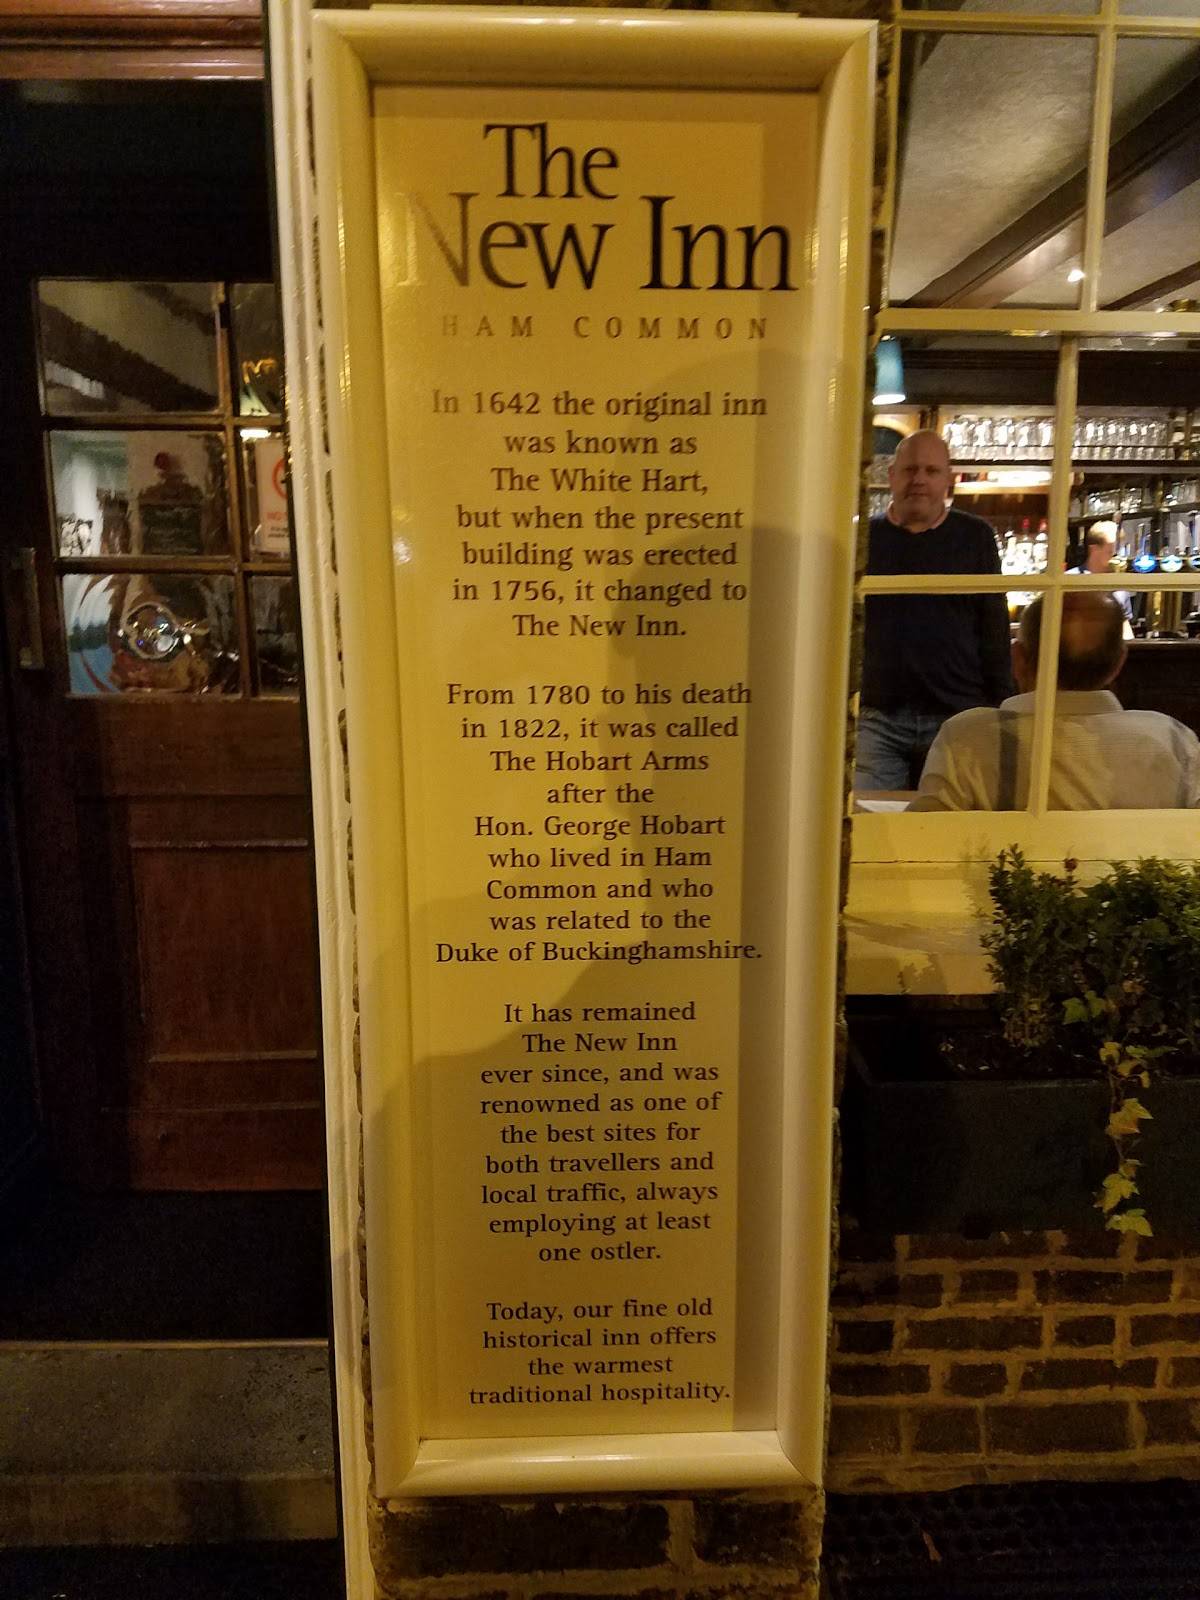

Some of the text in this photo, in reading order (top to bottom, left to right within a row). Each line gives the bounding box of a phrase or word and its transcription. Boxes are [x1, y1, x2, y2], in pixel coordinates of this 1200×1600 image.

[483, 122, 619, 199] The
[400, 190, 799, 291] New Inn
[442, 314, 767, 340] HAM COMMON
[433, 390, 768, 423] In 1642 the original inn
[503, 429, 697, 455] was known as
[490, 467, 708, 496] The White Hart,
[456, 504, 744, 536] but when the present
[462, 541, 739, 572] building was erected
[453, 578, 747, 607] in 1756, it changed to
[512, 614, 687, 637] The New Inn.
[447, 682, 753, 705] From 1780 to his death
[461, 716, 739, 741] in 1822, it was called
[490, 750, 709, 771] The Hobart Arms
[547, 782, 655, 804] after the
[474, 814, 726, 841] Hon. George Hobart
[488, 847, 712, 868] who lived in Ham
[487, 878, 714, 899] Common and who
[489, 909, 711, 930] was related to the
[435, 937, 763, 965] Duke of Buckinghamshire.
[504, 1001, 697, 1022] It has remained
[522, 1032, 678, 1053] The New Inn
[481, 1062, 719, 1085] ever since, and was
[480, 1091, 723, 1114] renowned as one of
[500, 1121, 701, 1144] the best sites for
[485, 1151, 714, 1174] both travellers and
[481, 1182, 718, 1205] local traffic, always
[489, 1211, 711, 1238] employing at least
[538, 1241, 662, 1262] one ostler.
[486, 1297, 713, 1325] Today, our fine old
[483, 1326, 716, 1349] historical inn offers
[528, 1356, 673, 1375] the warmest
[469, 1381, 730, 1405] traditional hospitality.
